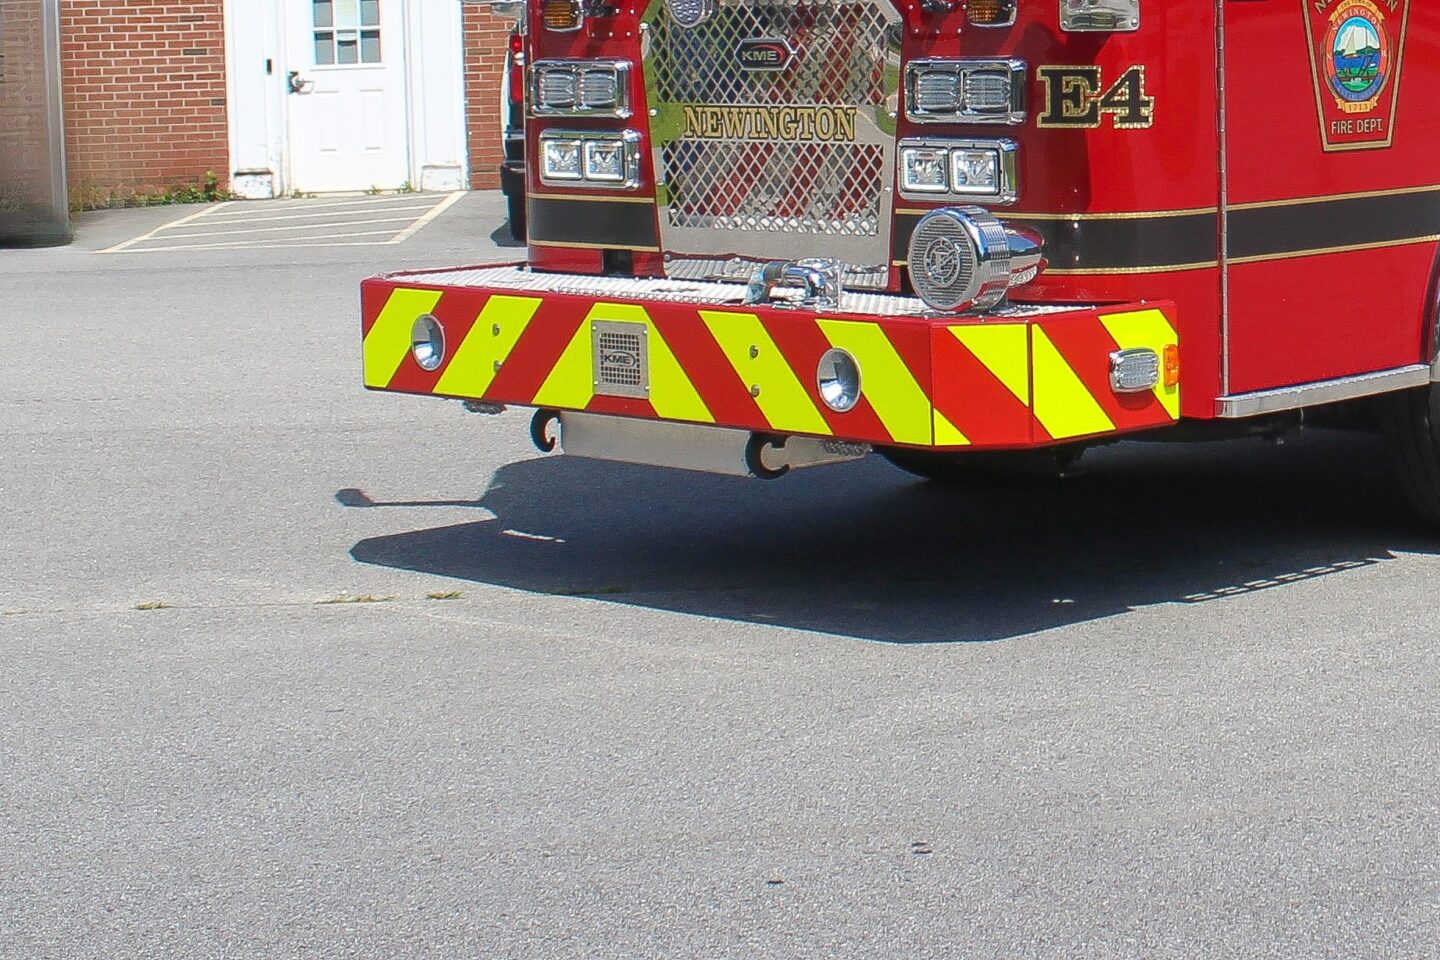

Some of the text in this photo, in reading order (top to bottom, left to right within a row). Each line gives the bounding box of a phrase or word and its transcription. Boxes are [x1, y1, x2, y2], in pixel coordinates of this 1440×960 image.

[741, 50, 778, 61] KME
[1036, 64, 1155, 128] E4
[683, 104, 857, 141] NEWINGTON
[1331, 121, 1353, 135] FIRE
[604, 354, 631, 365] KME
